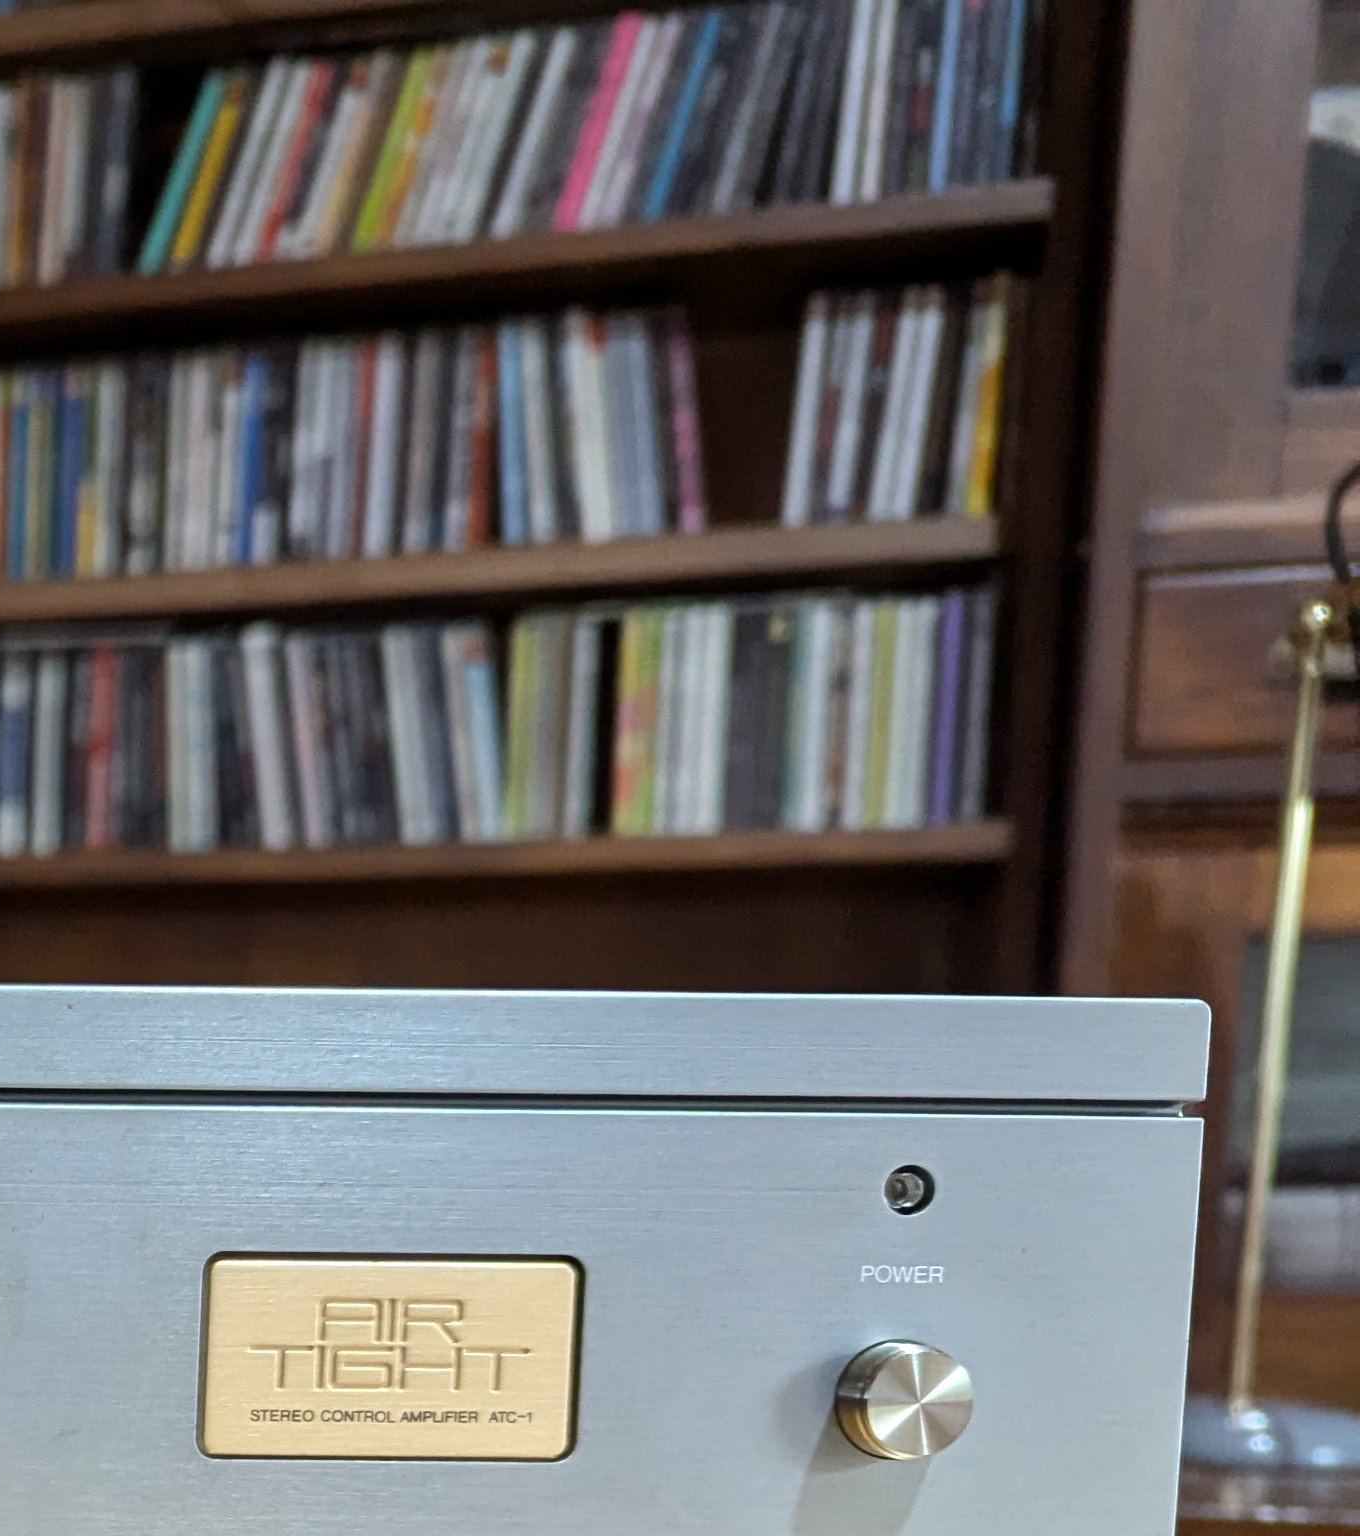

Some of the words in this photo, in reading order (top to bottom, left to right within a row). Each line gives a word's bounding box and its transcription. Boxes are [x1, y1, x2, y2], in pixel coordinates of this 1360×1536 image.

[860, 1265, 944, 1284] POWER
[315, 1296, 464, 1345] AIR
[247, 1343, 531, 1393] TIGHT
[250, 1409, 315, 1423] STEREO
[320, 1409, 395, 1423] CONTROL
[399, 1410, 479, 1424] AMPLIFIER
[488, 1410, 533, 1424] ATC-1
